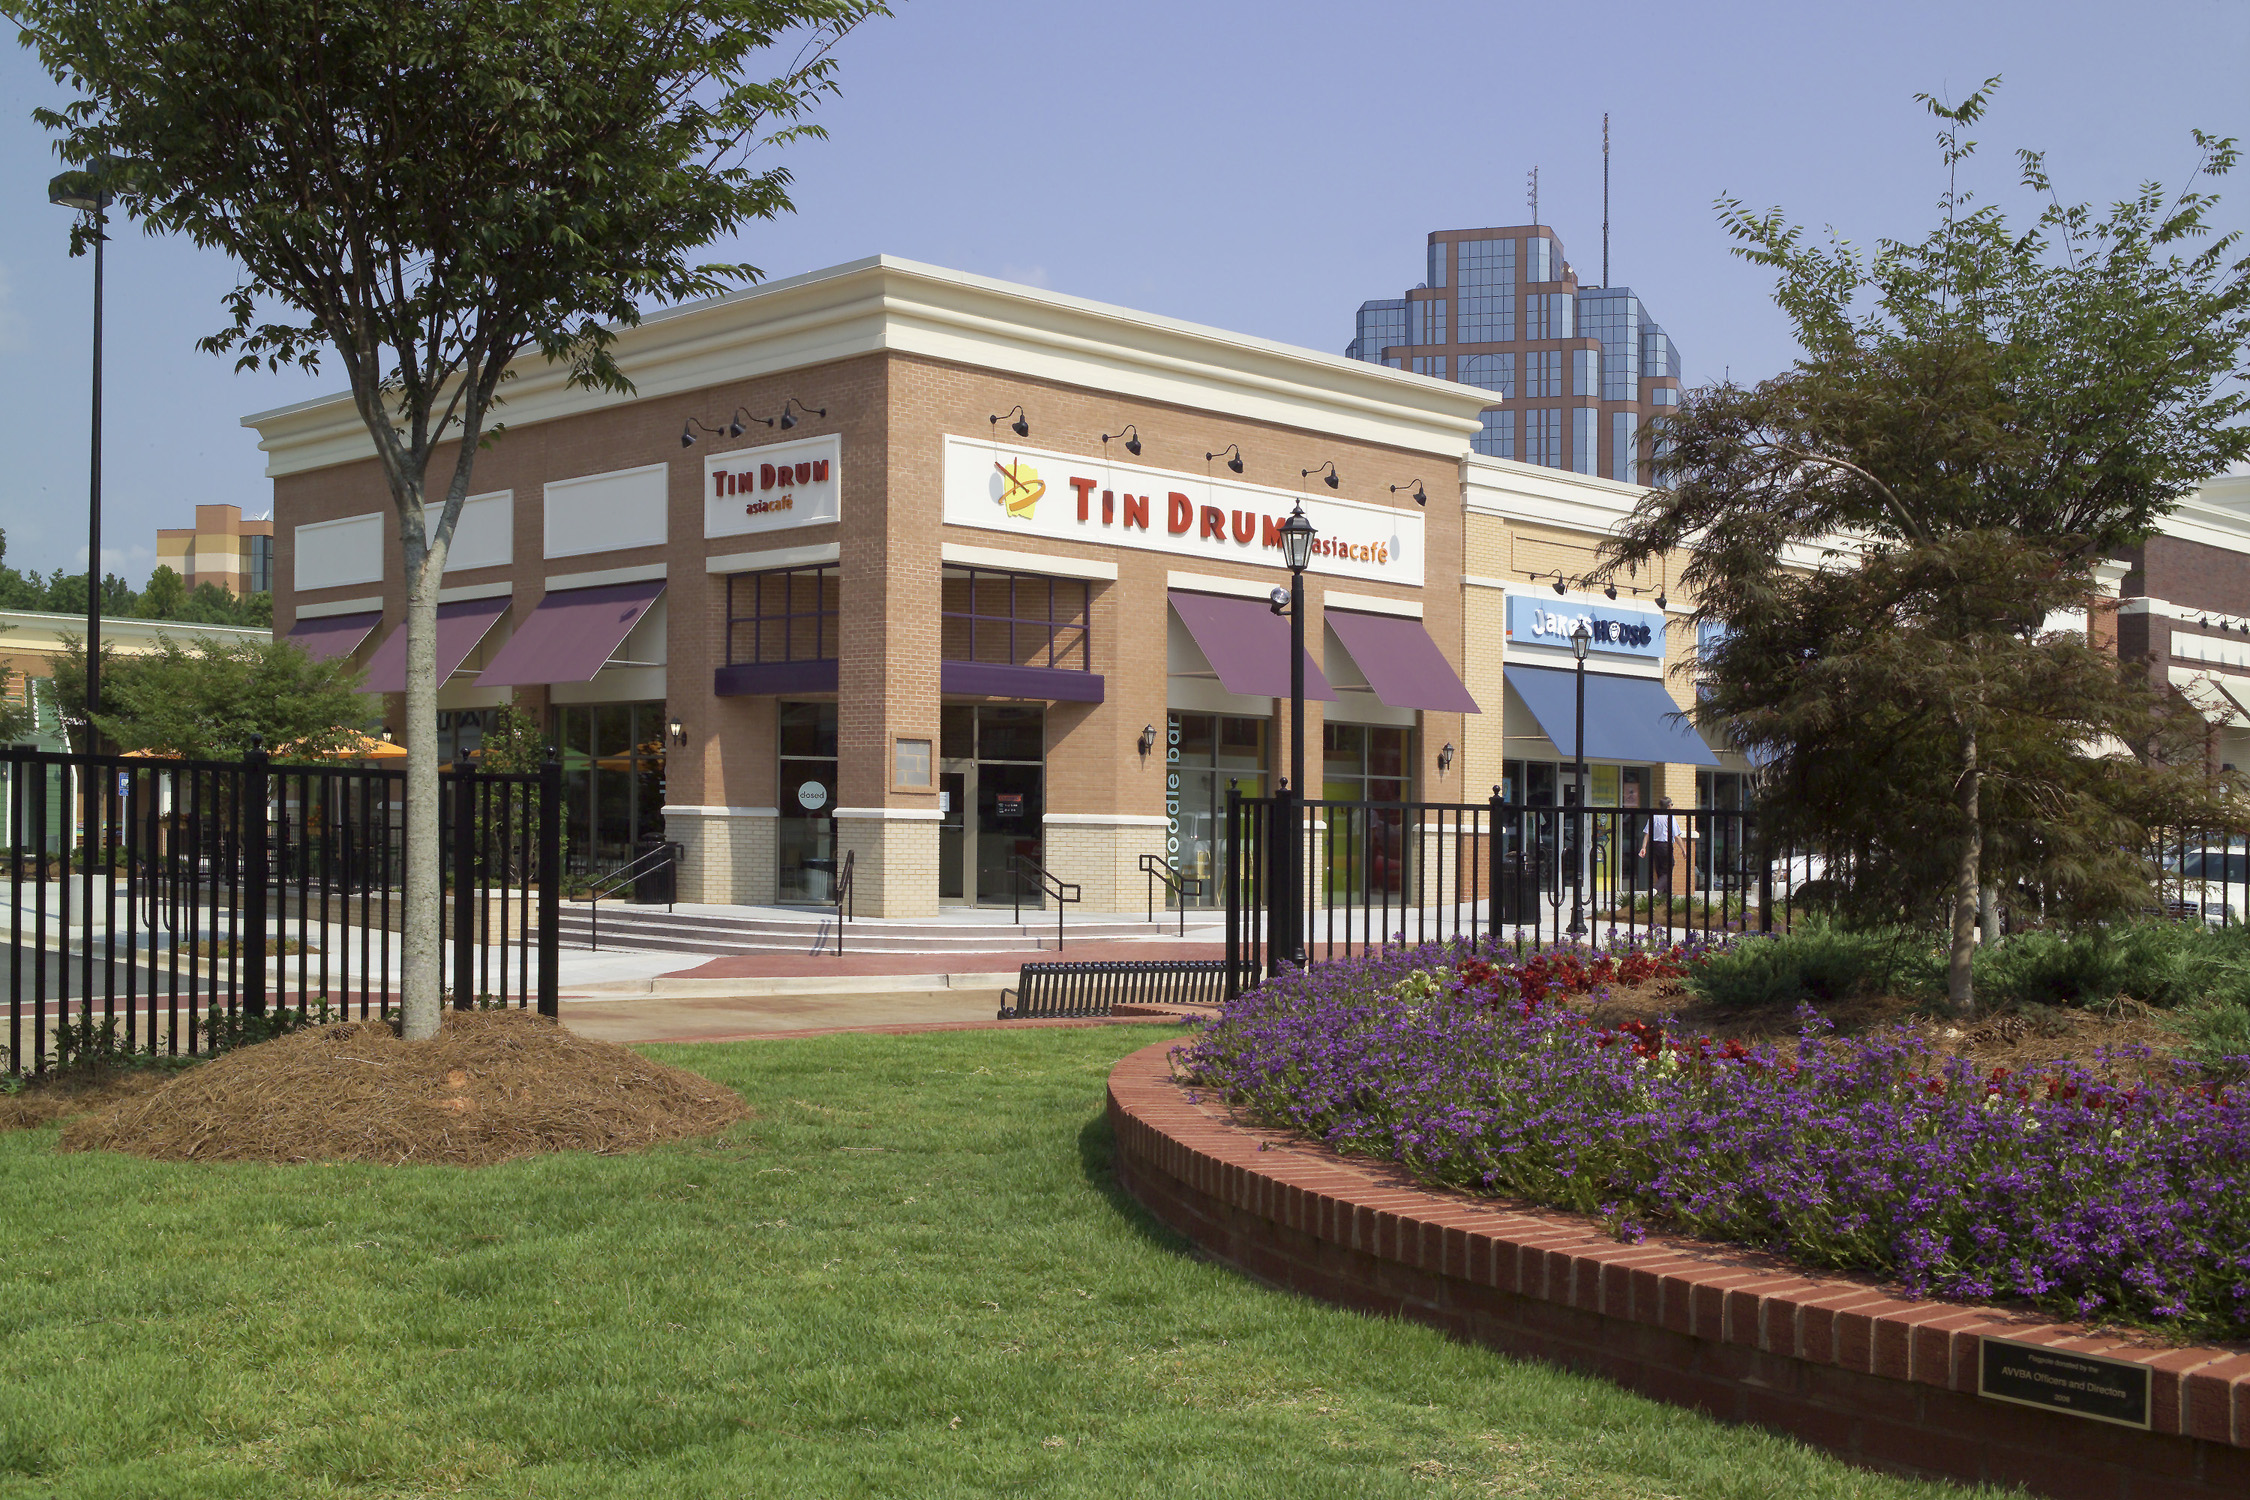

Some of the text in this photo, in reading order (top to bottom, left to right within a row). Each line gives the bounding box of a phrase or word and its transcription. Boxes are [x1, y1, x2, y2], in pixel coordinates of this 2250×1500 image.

[712, 459, 829, 497] TIN DRUM
[1069, 476, 1149, 529] TIN
[1166, 716, 1180, 871] noodle bar
[2001, 1366, 2127, 1398] AVVBA Officers and Directors
